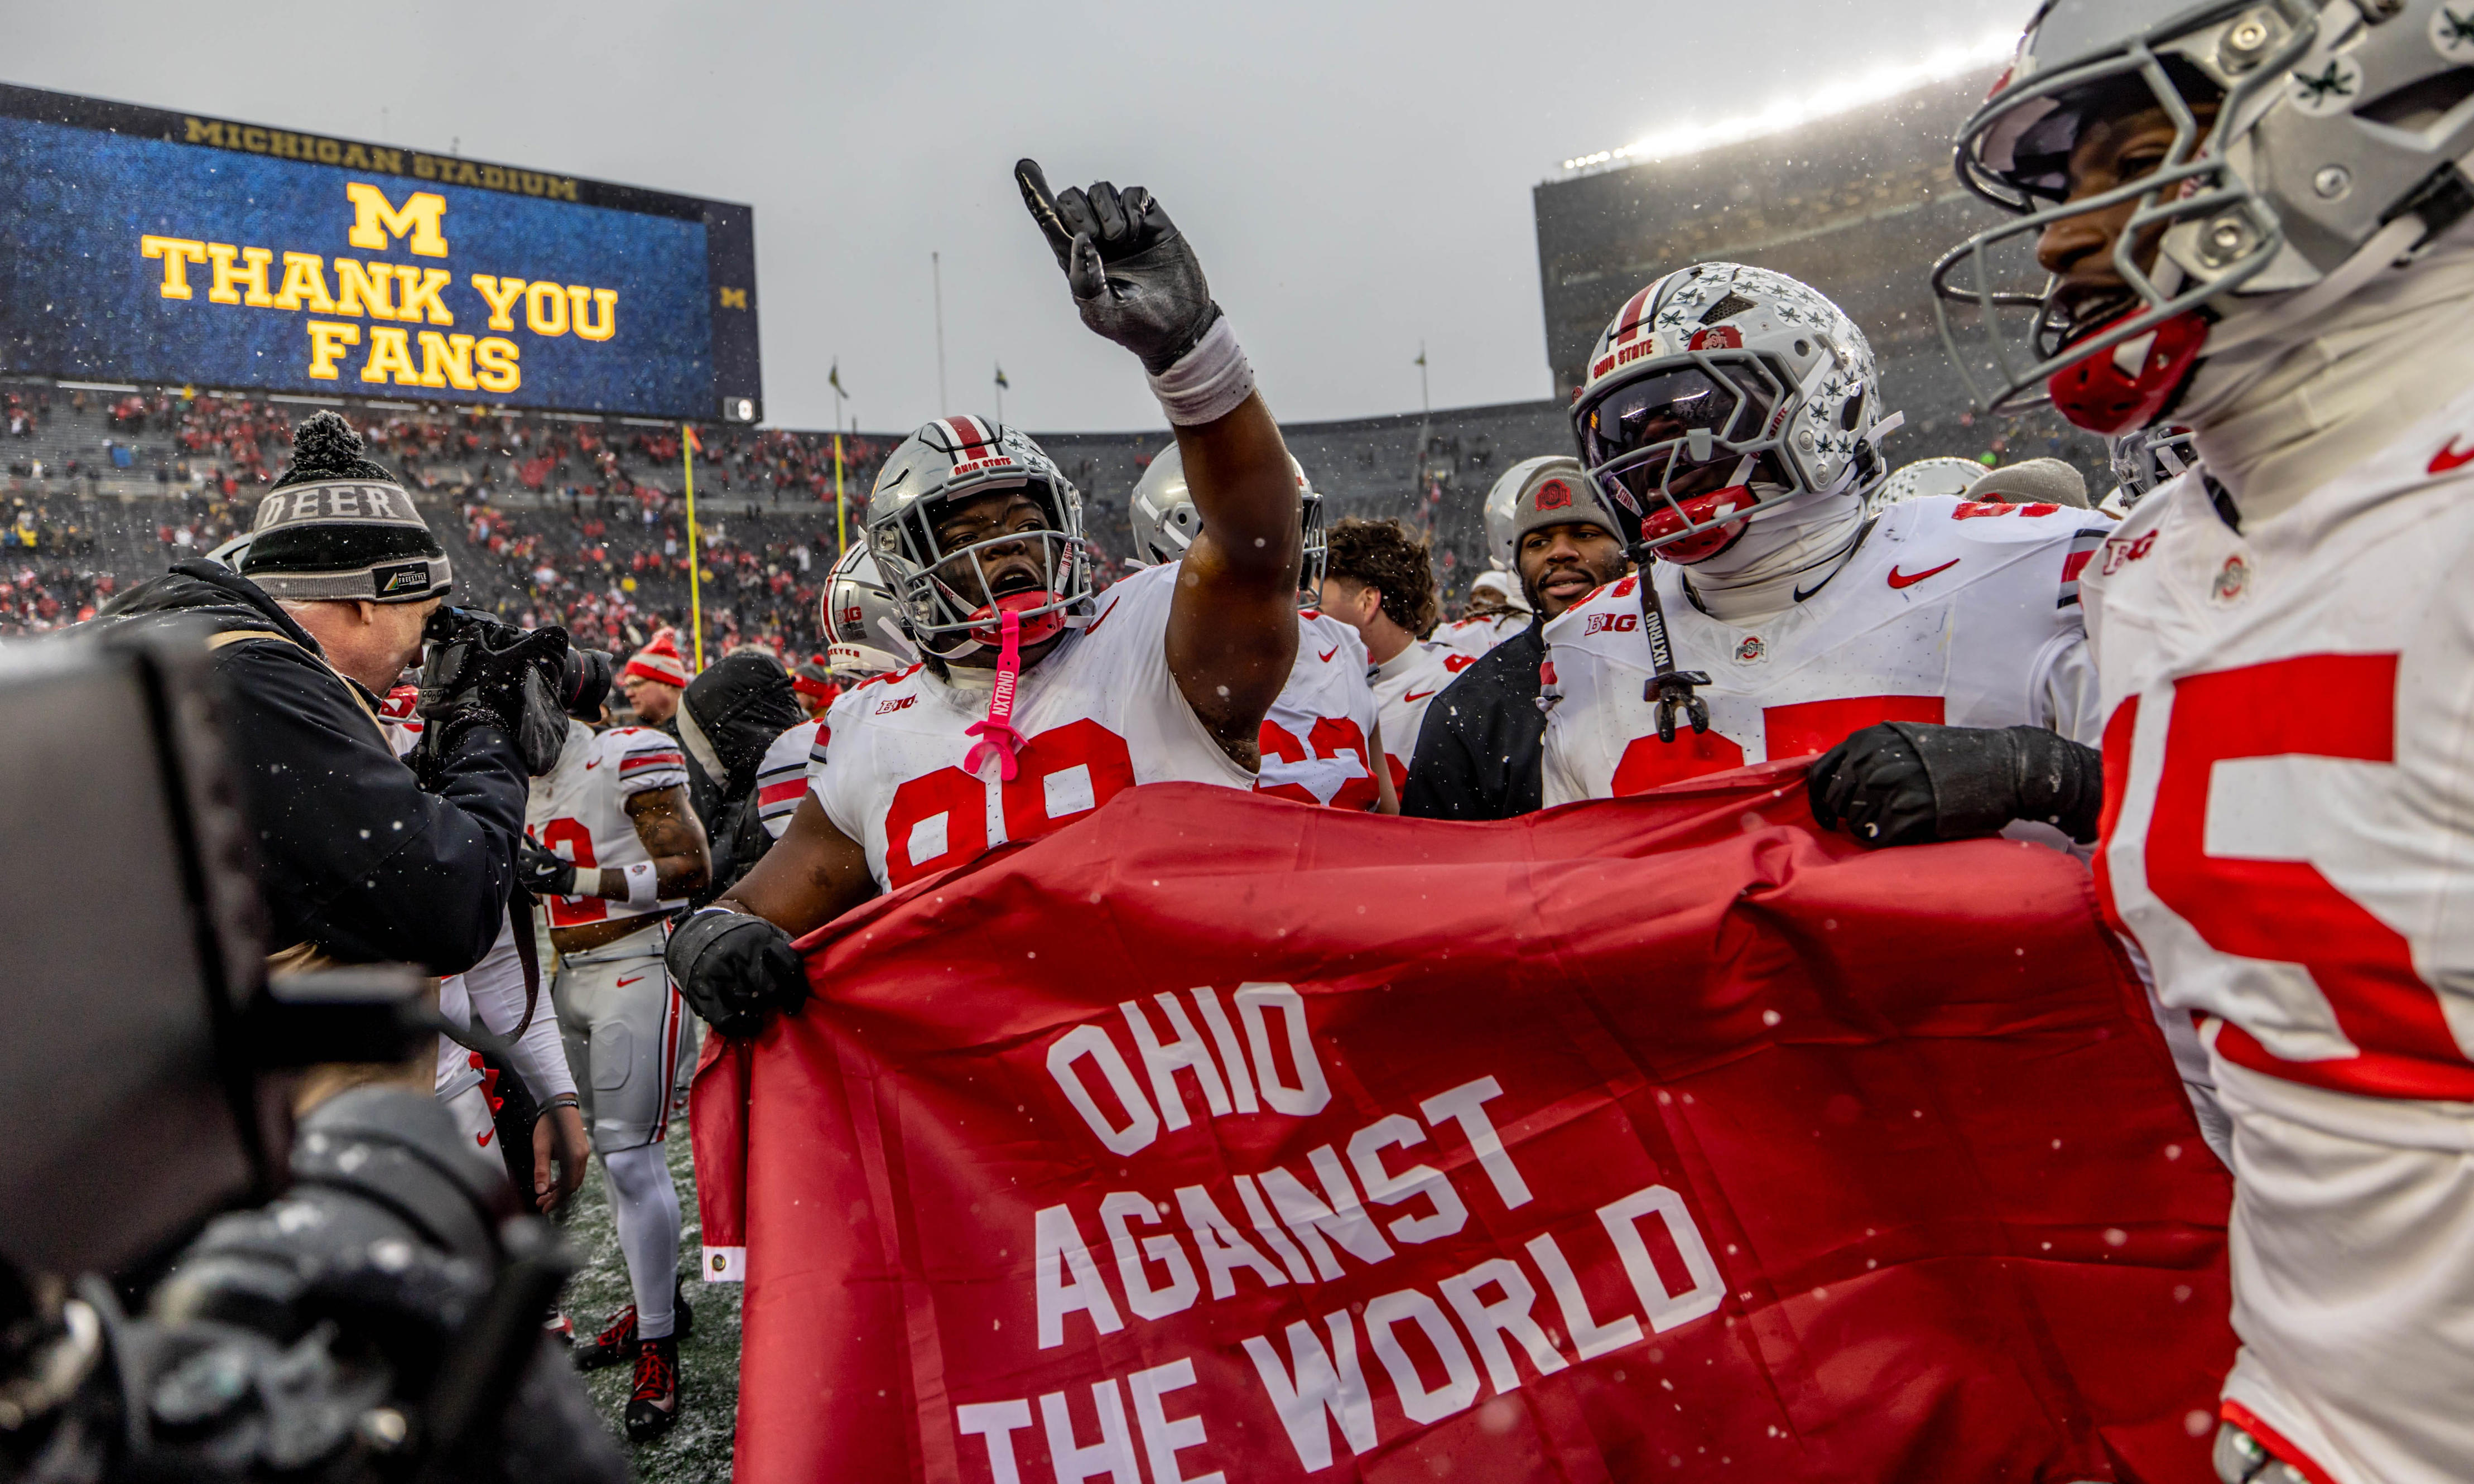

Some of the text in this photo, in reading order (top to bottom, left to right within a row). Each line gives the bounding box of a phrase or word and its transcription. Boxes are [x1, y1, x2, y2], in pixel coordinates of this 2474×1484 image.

[184, 117, 578, 201] MICHIGAN STADIUM
[346, 182, 448, 258] M
[141, 235, 618, 341] THANK YOU
[720, 286, 747, 310] M
[307, 320, 521, 393] FANS
[1594, 338, 1653, 379] OHIO STATE
[954, 457, 1012, 475] OHIO STATE
[260, 485, 402, 530] DEER
[1618, 488, 1633, 509] STATE
[398, 573, 427, 584] FREESTYLE
[1645, 611, 1670, 668] NXTRND
[991, 669, 1015, 717] NXTRND
[1046, 981, 1332, 1157] OHIO
[1035, 1075, 1534, 1350] AGAINST
[956, 1183, 1727, 1484] THE WORLD
